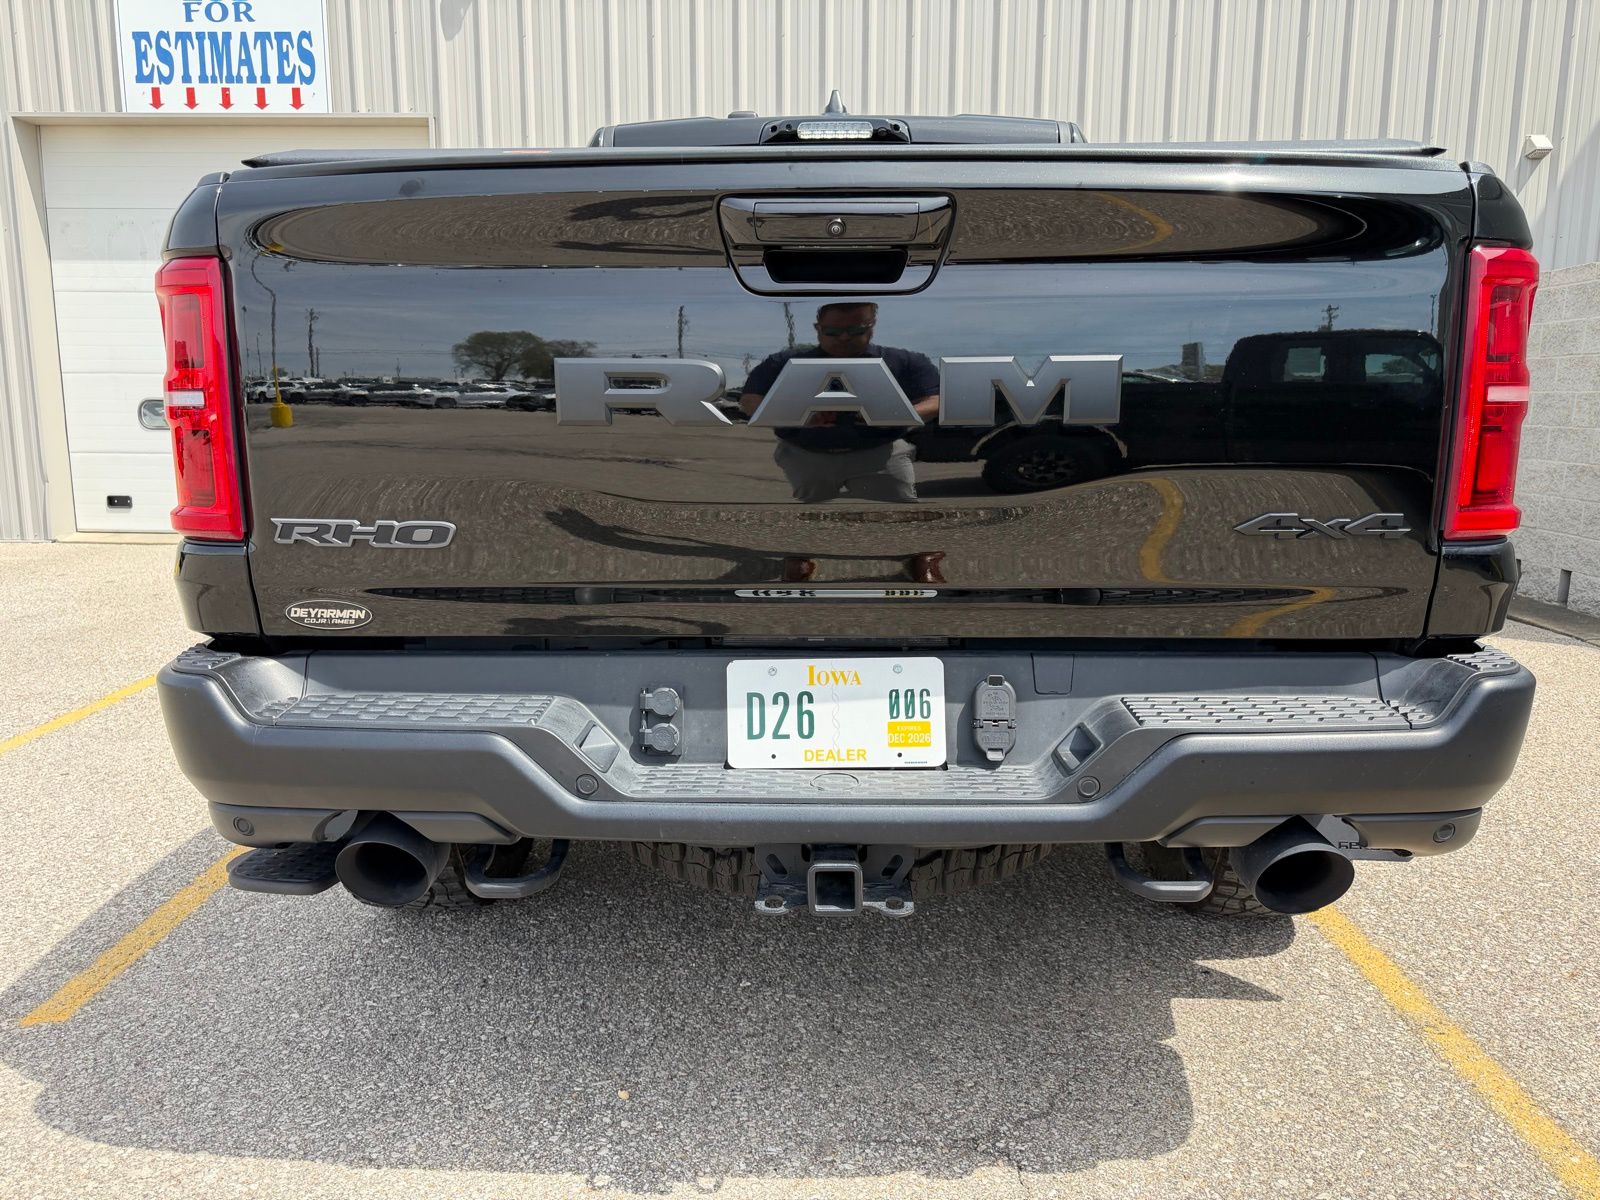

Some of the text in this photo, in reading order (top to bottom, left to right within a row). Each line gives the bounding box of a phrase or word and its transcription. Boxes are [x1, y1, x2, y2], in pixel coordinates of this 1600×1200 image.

[182, 2, 256, 23] FOR
[132, 30, 316, 86] ESTIMATES
[553, 355, 1124, 427] RAM
[270, 517, 457, 549] RHO
[290, 607, 366, 619] DEYARMAN
[746, 688, 931, 740] D26 006
[888, 733, 931, 743] DEC 2026
[804, 749, 867, 762] DEALER
